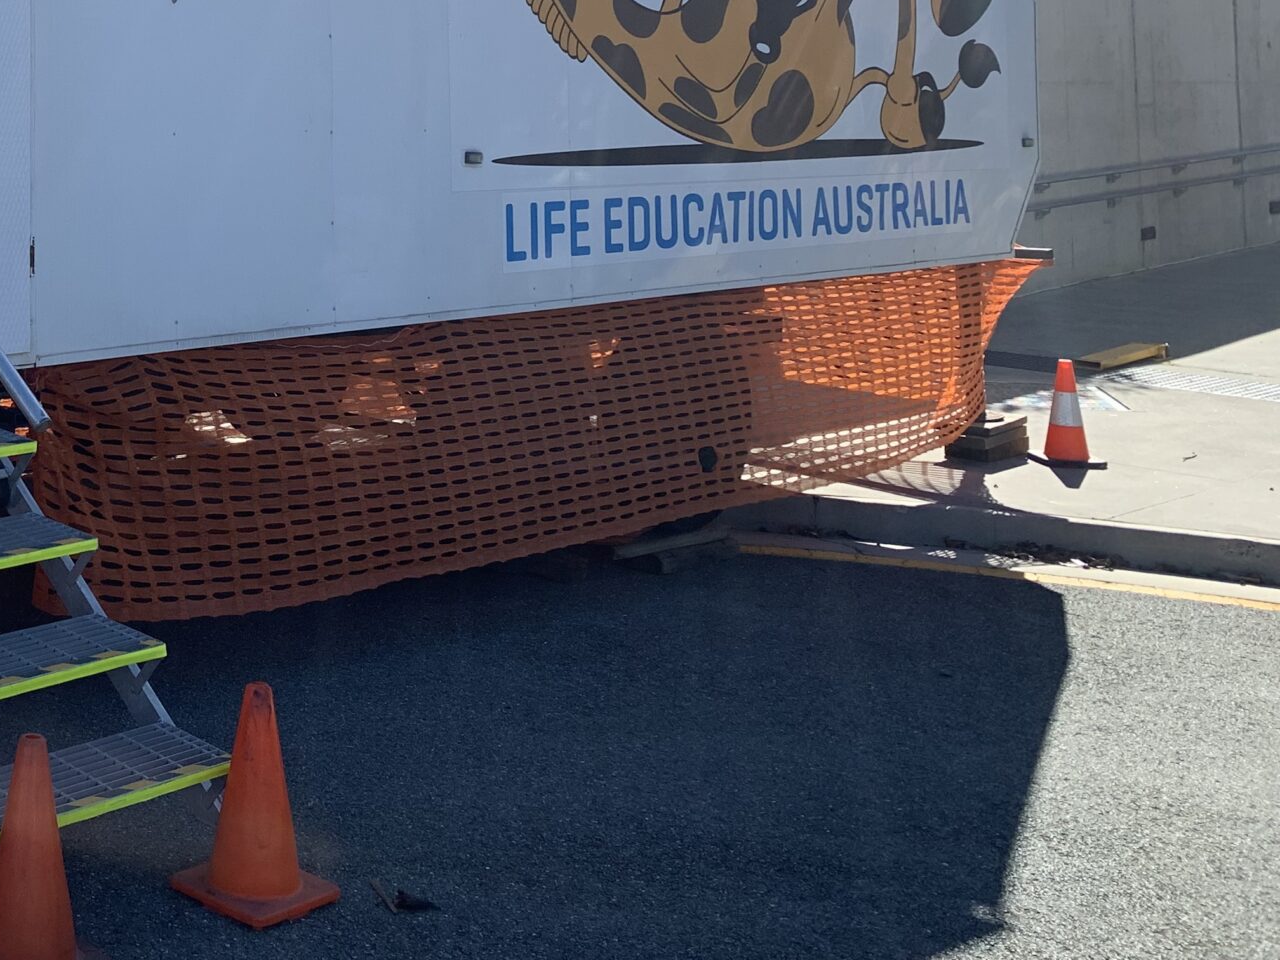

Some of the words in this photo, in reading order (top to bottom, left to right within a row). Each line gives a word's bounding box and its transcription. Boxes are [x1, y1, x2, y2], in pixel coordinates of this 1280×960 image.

[505, 198, 592, 263] LIFE
[603, 188, 803, 254] EDUCATION
[811, 178, 972, 238] AUSTRALIA
